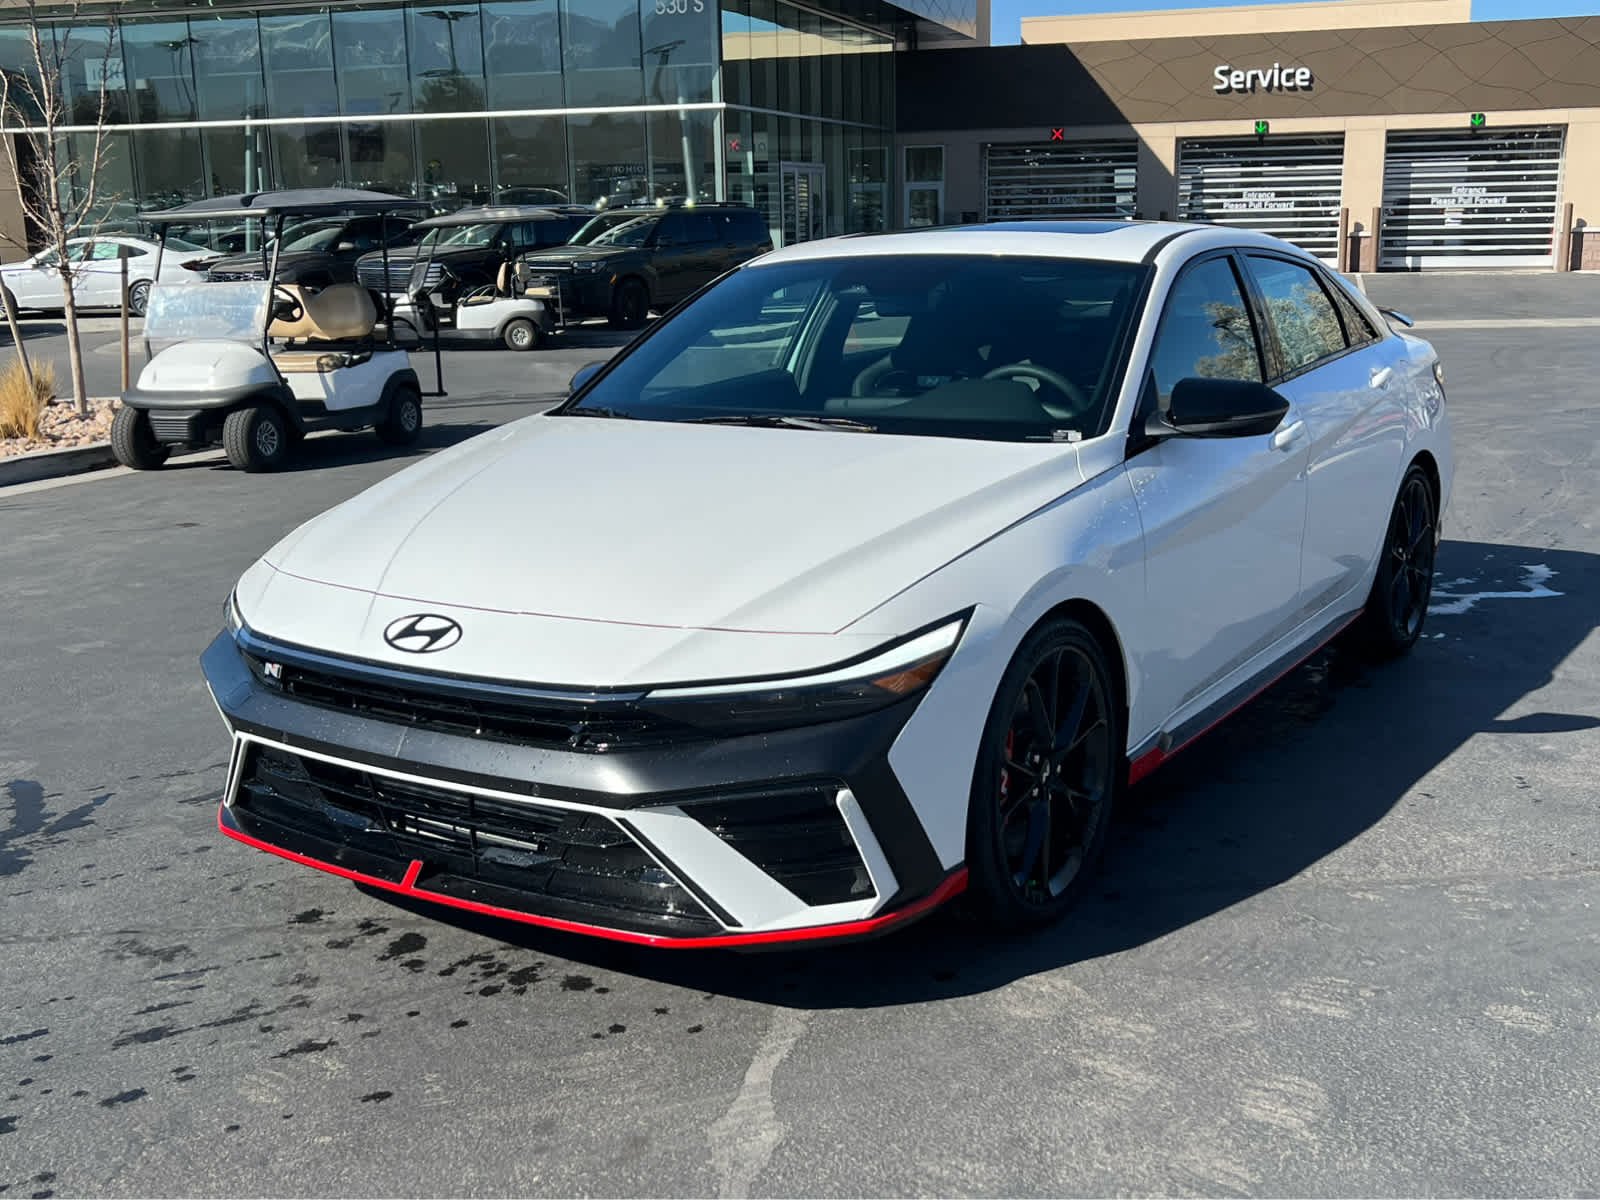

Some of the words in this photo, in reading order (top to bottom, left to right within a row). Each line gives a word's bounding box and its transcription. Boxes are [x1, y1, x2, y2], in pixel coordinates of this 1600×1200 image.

[1213, 62, 1311, 90] Service
[1242, 191, 1276, 199] Entrance
[1452, 186, 1487, 195] Entrance
[1223, 201, 1248, 209] Please
[1248, 201, 1263, 209] Pull
[1264, 200, 1295, 209] Forward
[1430, 197, 1457, 206] Please
[1457, 196, 1473, 205] Pull
[1474, 196, 1507, 204] Forward
